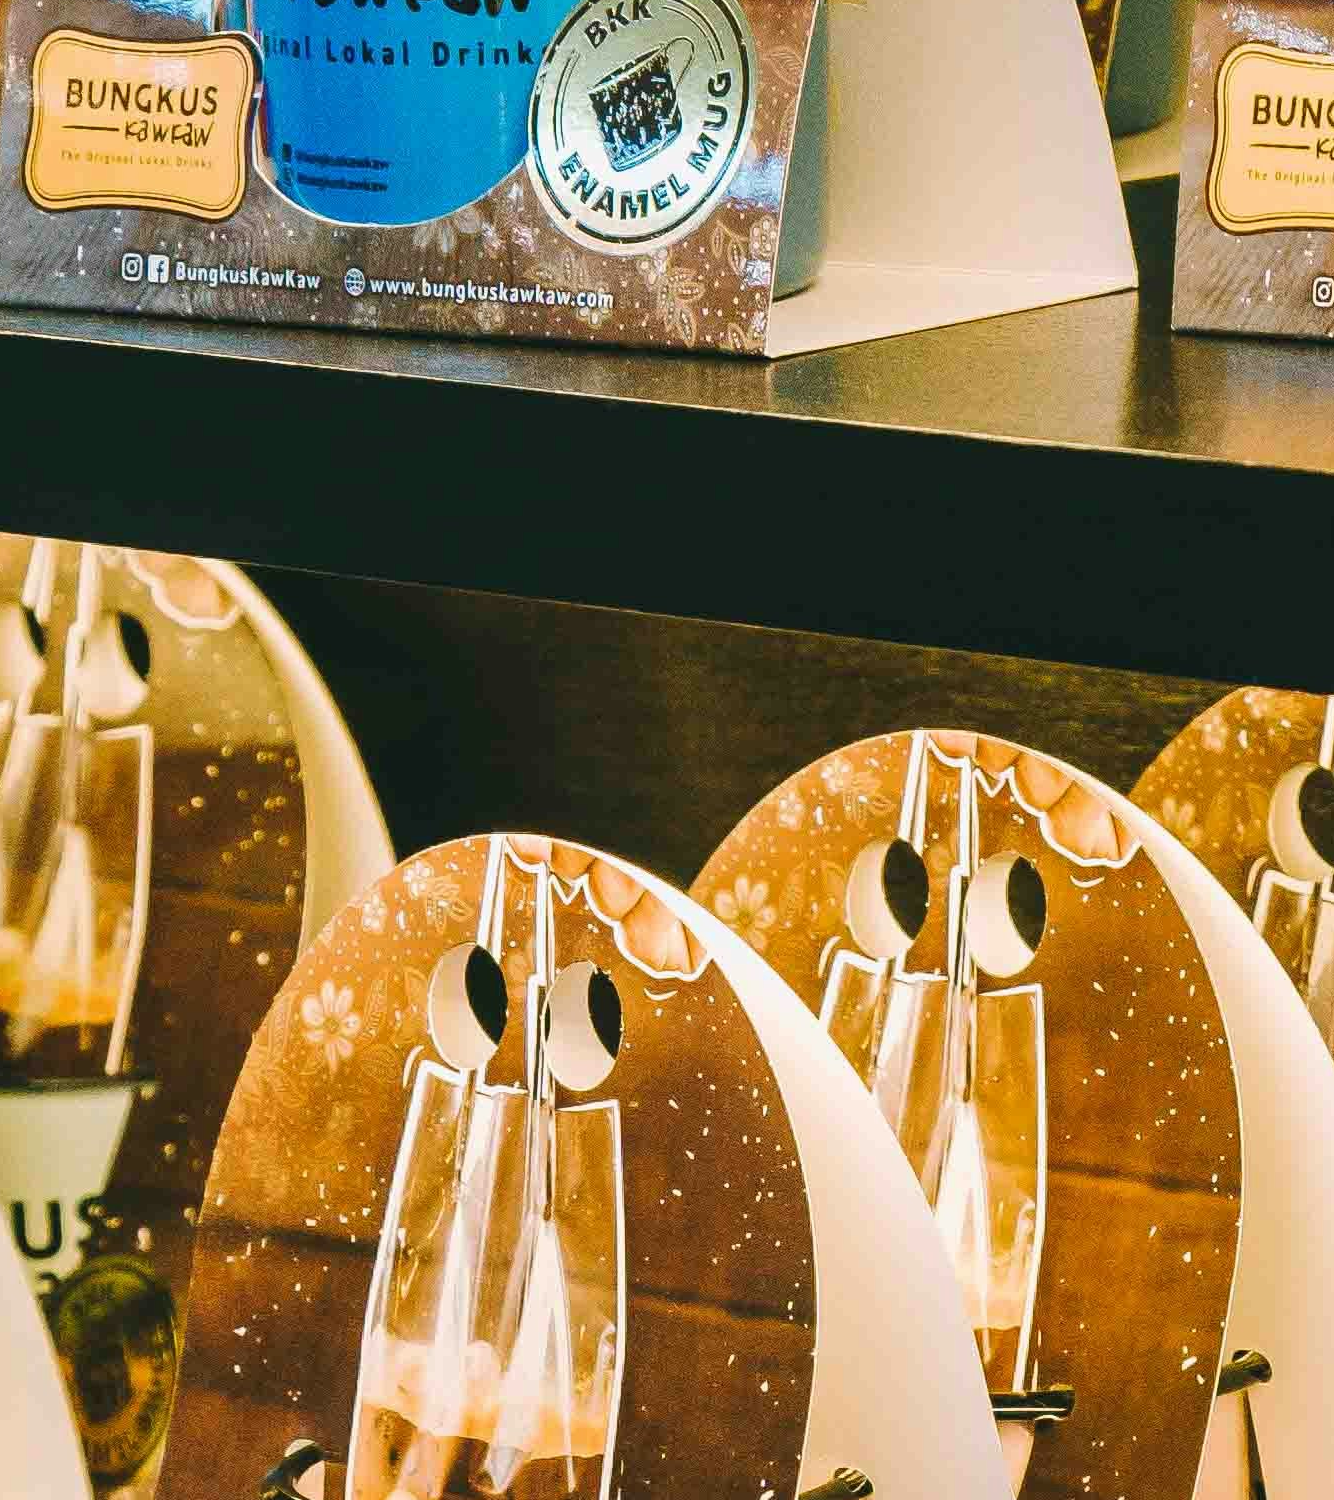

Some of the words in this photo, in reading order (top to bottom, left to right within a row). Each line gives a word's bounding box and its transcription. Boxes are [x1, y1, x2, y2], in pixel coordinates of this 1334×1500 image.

[325, 39, 410, 68] Lokal
[65, 77, 219, 117] BUNGKUS
[557, 150, 691, 221] ENAMEL
[686, 70, 732, 173] MUG
[174, 261, 321, 291] BungkusKawKaw
[370, 278, 615, 310] www.bungkuskawkaw.com
